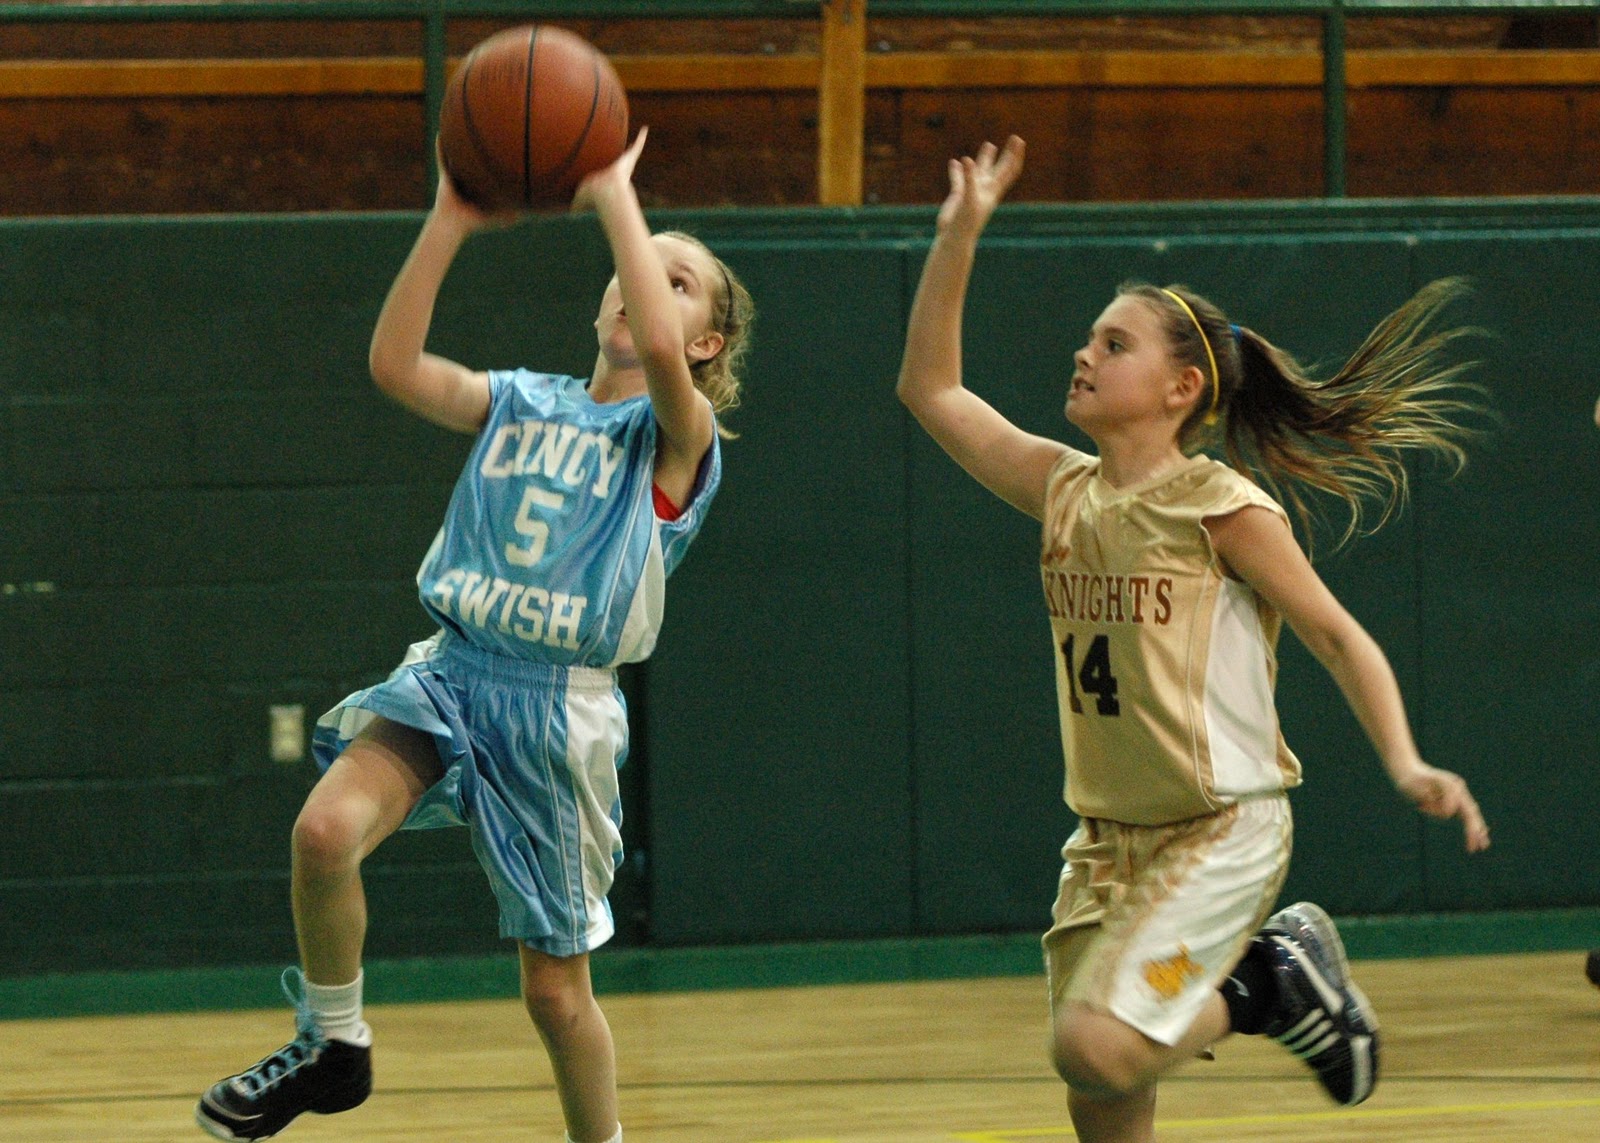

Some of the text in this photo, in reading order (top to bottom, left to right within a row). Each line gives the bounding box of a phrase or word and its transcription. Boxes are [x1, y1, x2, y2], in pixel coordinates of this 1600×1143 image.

[481, 421, 624, 498] CINCY
[504, 486, 564, 568] 5
[1061, 632, 1120, 716] 14
